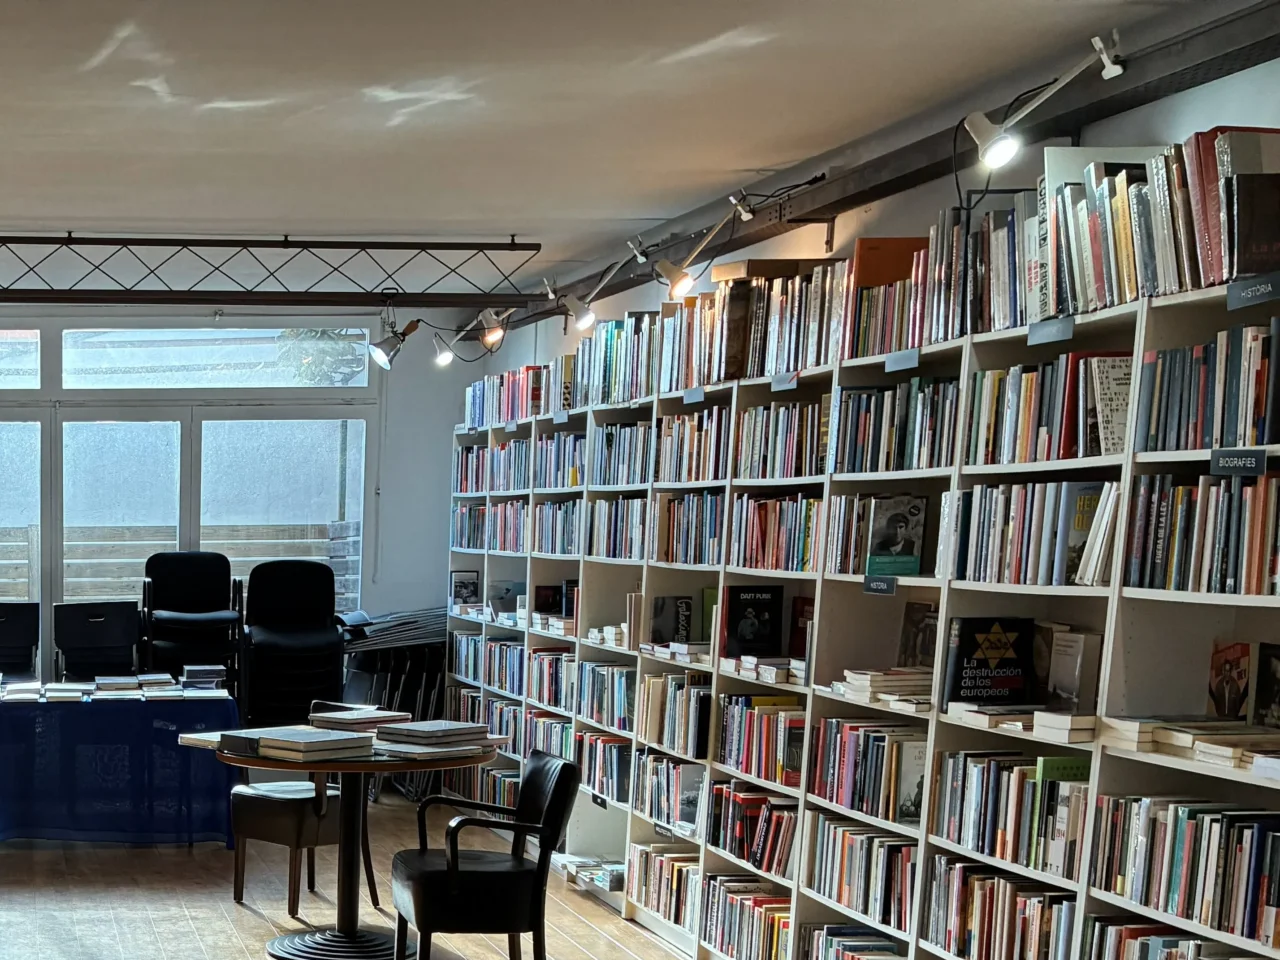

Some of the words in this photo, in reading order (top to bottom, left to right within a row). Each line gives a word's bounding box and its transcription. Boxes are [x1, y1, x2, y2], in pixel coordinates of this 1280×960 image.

[1240, 283, 1273, 299] HISTÒRIA
[1218, 457, 1256, 468] BIOGRAFIES
[1159, 501, 1168, 515] LEY
[1158, 516, 1166, 527] LA
[1157, 528, 1165, 538] DE
[1155, 538, 1164, 564] FUERA
[740, 592, 756, 600] DAFT
[963, 657, 977, 667] La
[962, 667, 1022, 677] destrucción
[961, 677, 975, 687] de
[976, 677, 992, 686] los
[960, 687, 1009, 698] europeos
